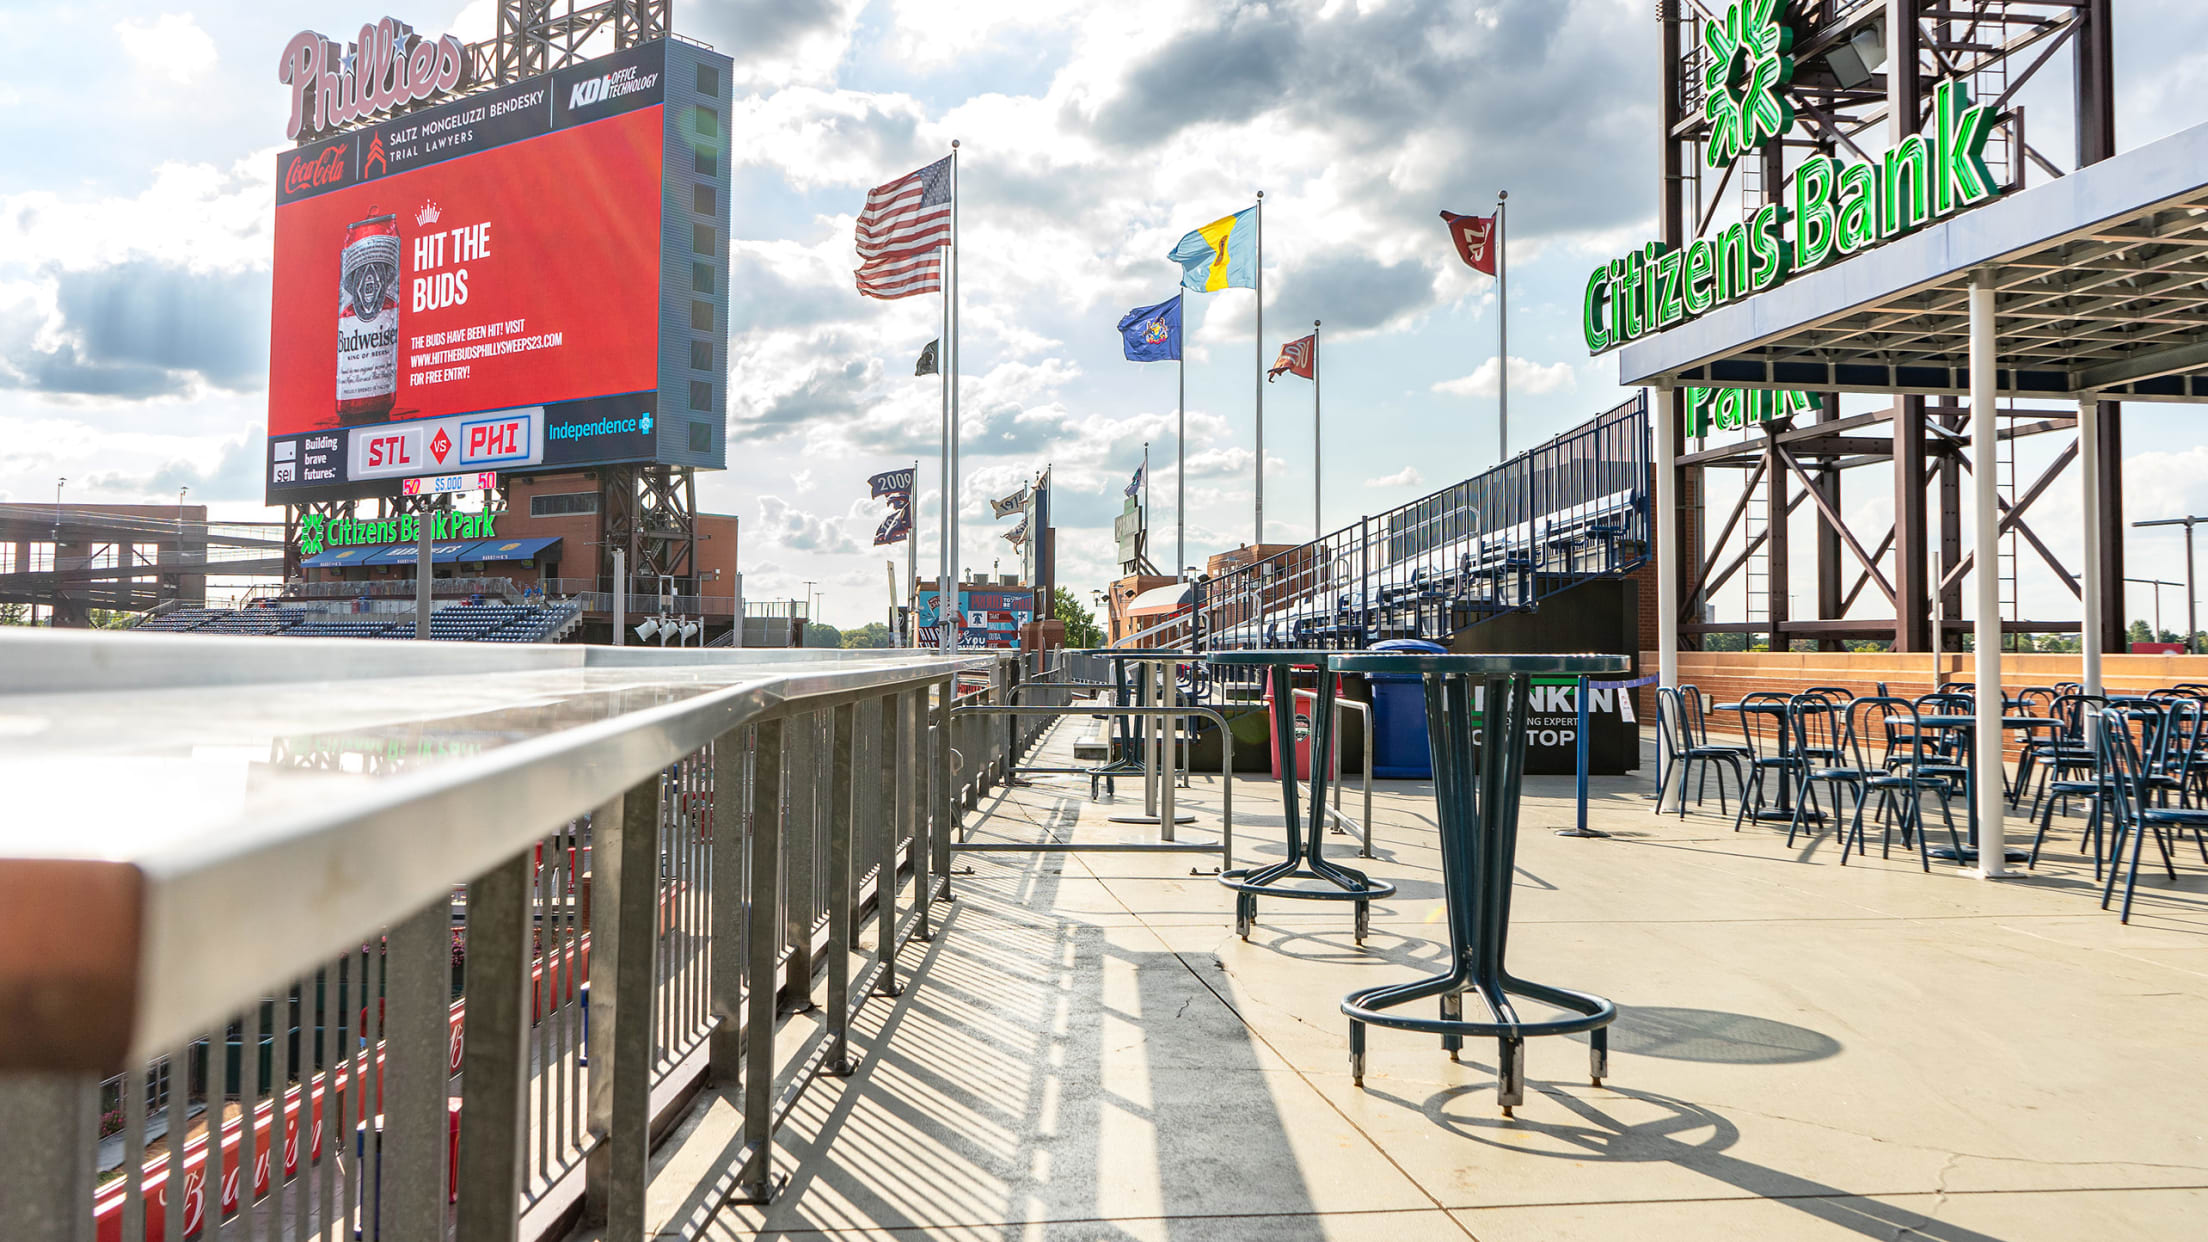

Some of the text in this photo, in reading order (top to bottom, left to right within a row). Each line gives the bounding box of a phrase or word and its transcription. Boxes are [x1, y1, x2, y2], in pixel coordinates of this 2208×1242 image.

[279, 16, 466, 140] Phillies
[609, 73, 659, 99] TECHNOLOGY
[611, 66, 638, 85] OFFICE
[390, 90, 545, 146] SALTZ MONGELUZZI BENDESKY
[390, 130, 473, 162] TRIAL LAWYERS
[1584, 76, 1999, 353] Citizens Bank
[413, 231, 447, 272] HIT
[451, 221, 491, 264] THE
[413, 268, 469, 313] BUDS
[338, 324, 398, 353] Budweiser
[411, 318, 526, 350] THE BUDS HAVE BEEN HIT! VISIT
[410, 332, 563, 368] WWW.HITTHEBUDSPHILLYSWEEPS23.COM
[410, 373, 424, 387] FOR
[425, 369, 443, 385] FREE
[444, 365, 471, 382] ENTRY!
[305, 436, 338, 451] Building
[469, 422, 519, 458] PHI
[549, 417, 636, 442] Independence
[304, 453, 327, 466] brave
[368, 435, 410, 467] STL
[433, 439, 447, 453] VS
[478, 472, 496, 489] 50
[877, 472, 911, 491] 2009
[327, 517, 398, 547] Citizens
[451, 506, 496, 540] Park
[971, 595, 1003, 609] PROUD
